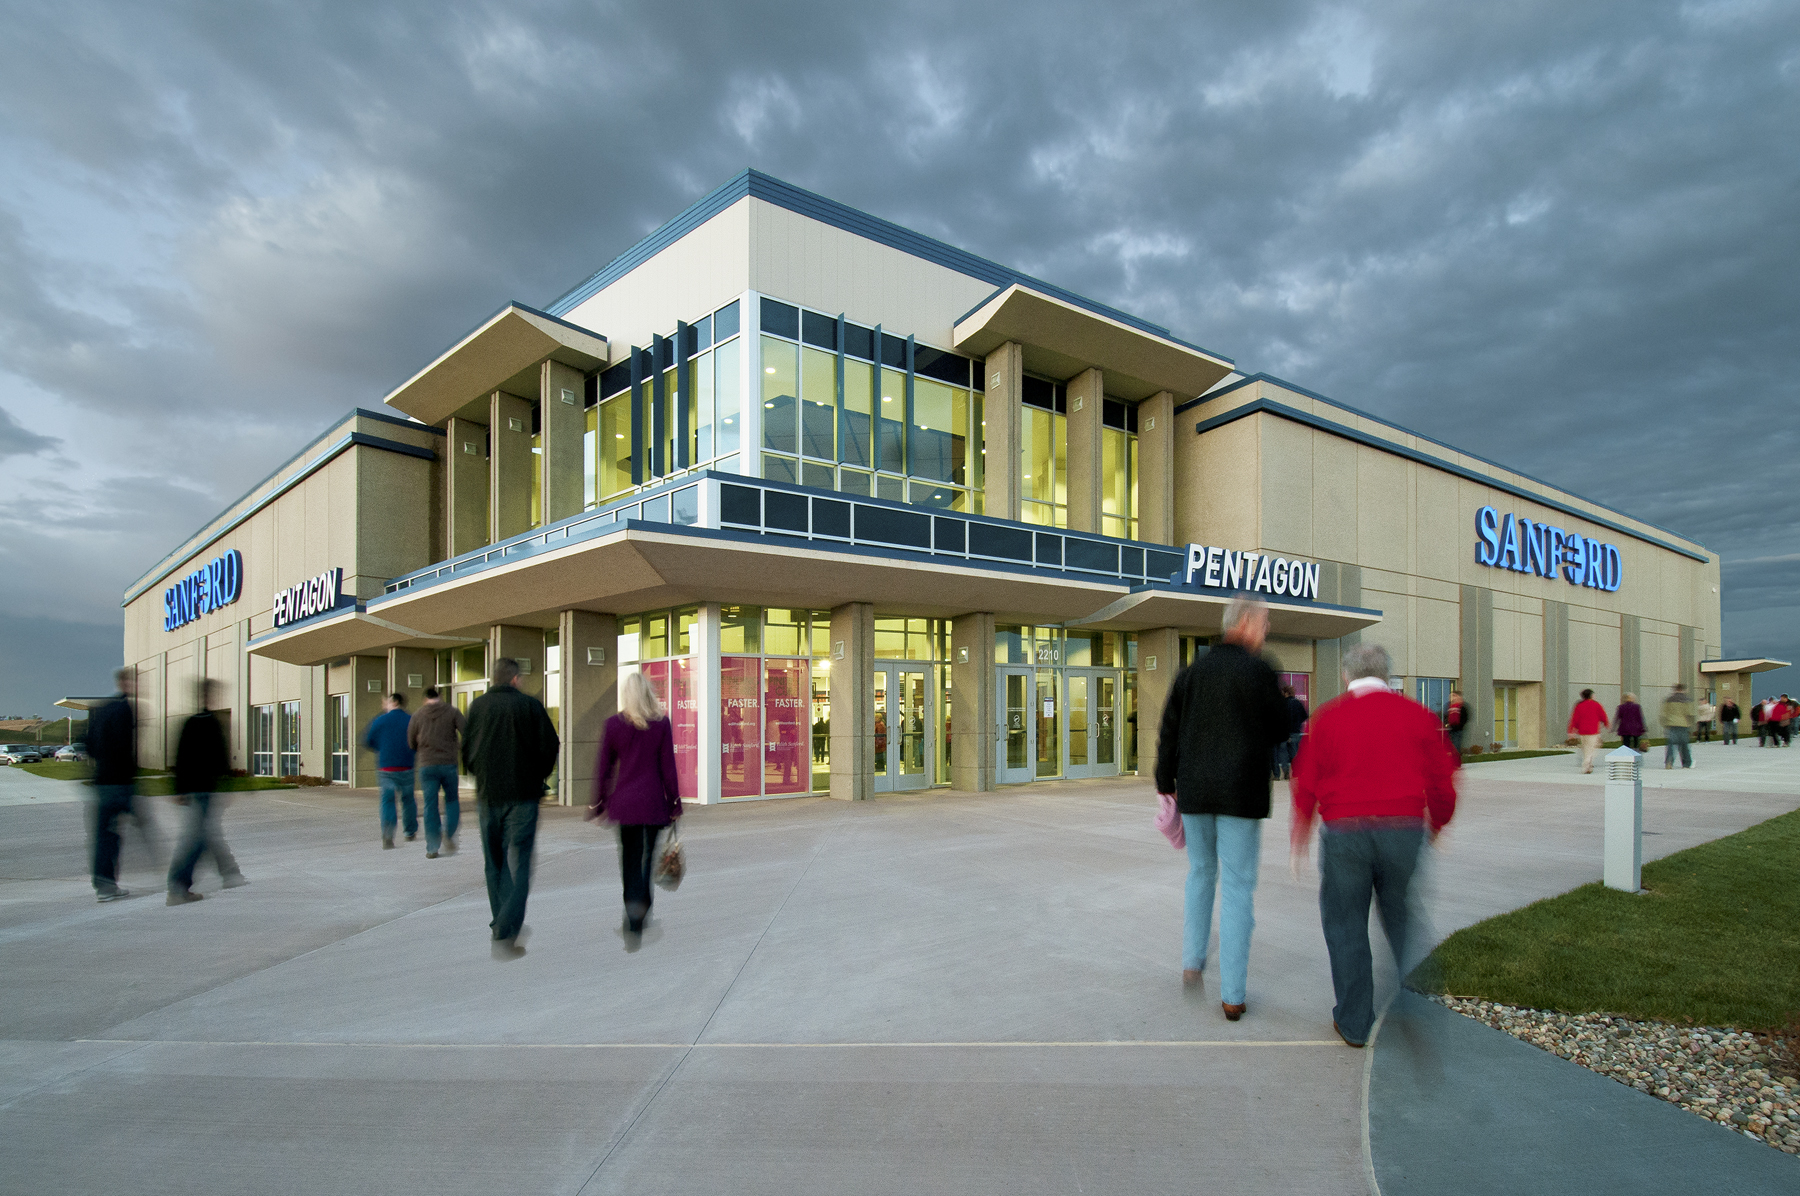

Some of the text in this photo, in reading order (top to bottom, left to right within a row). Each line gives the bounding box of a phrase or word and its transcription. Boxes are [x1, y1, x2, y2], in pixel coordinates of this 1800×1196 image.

[1185, 543, 1320, 599] PENTAGON
[1476, 505, 1622, 592] SANFORD
[164, 549, 241, 632] SANFORD
[272, 567, 341, 628] PENTAGON
[1038, 649, 1059, 660] 2210
[728, 698, 760, 708] FASTER.
[775, 698, 805, 708] FASTER.
